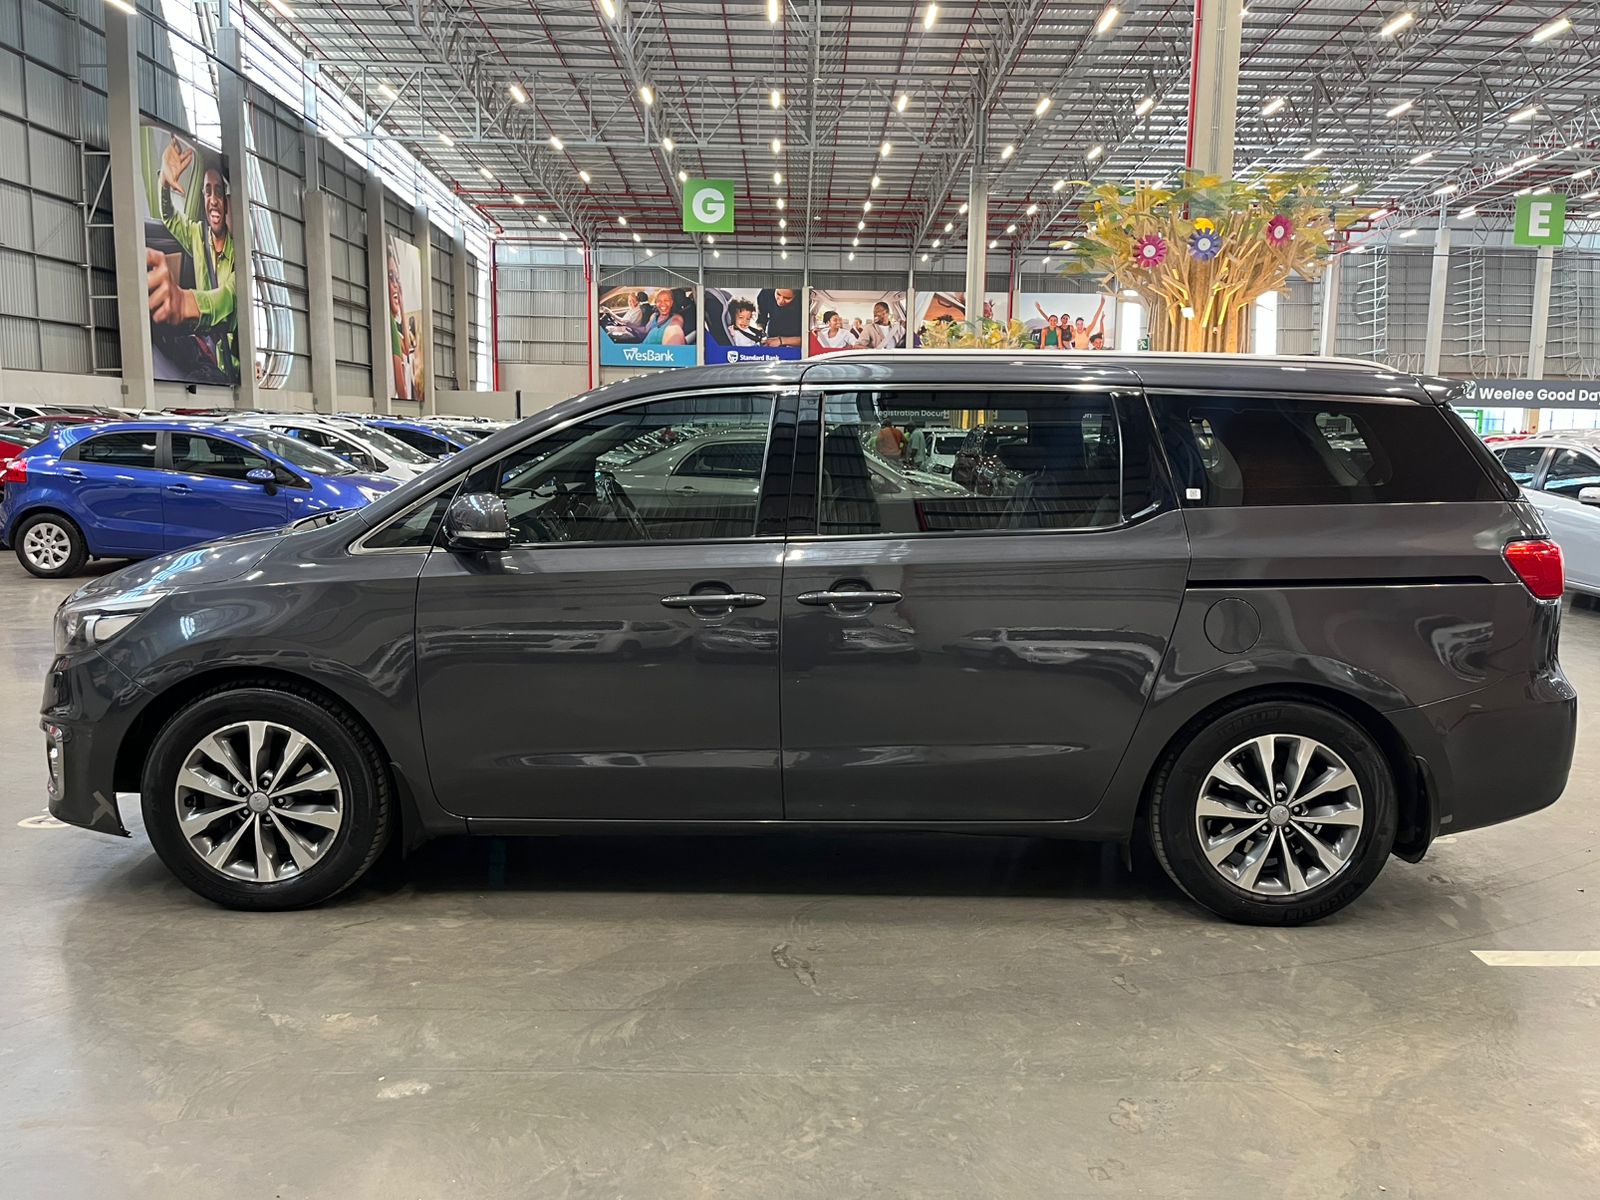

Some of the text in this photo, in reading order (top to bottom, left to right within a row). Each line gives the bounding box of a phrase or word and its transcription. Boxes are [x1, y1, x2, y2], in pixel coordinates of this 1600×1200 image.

[692, 187, 725, 224] G
[1528, 202, 1552, 237] E
[623, 347, 674, 362] WesBank
[1479, 387, 1534, 400] Weelee
[1537, 389, 1575, 401] Good
